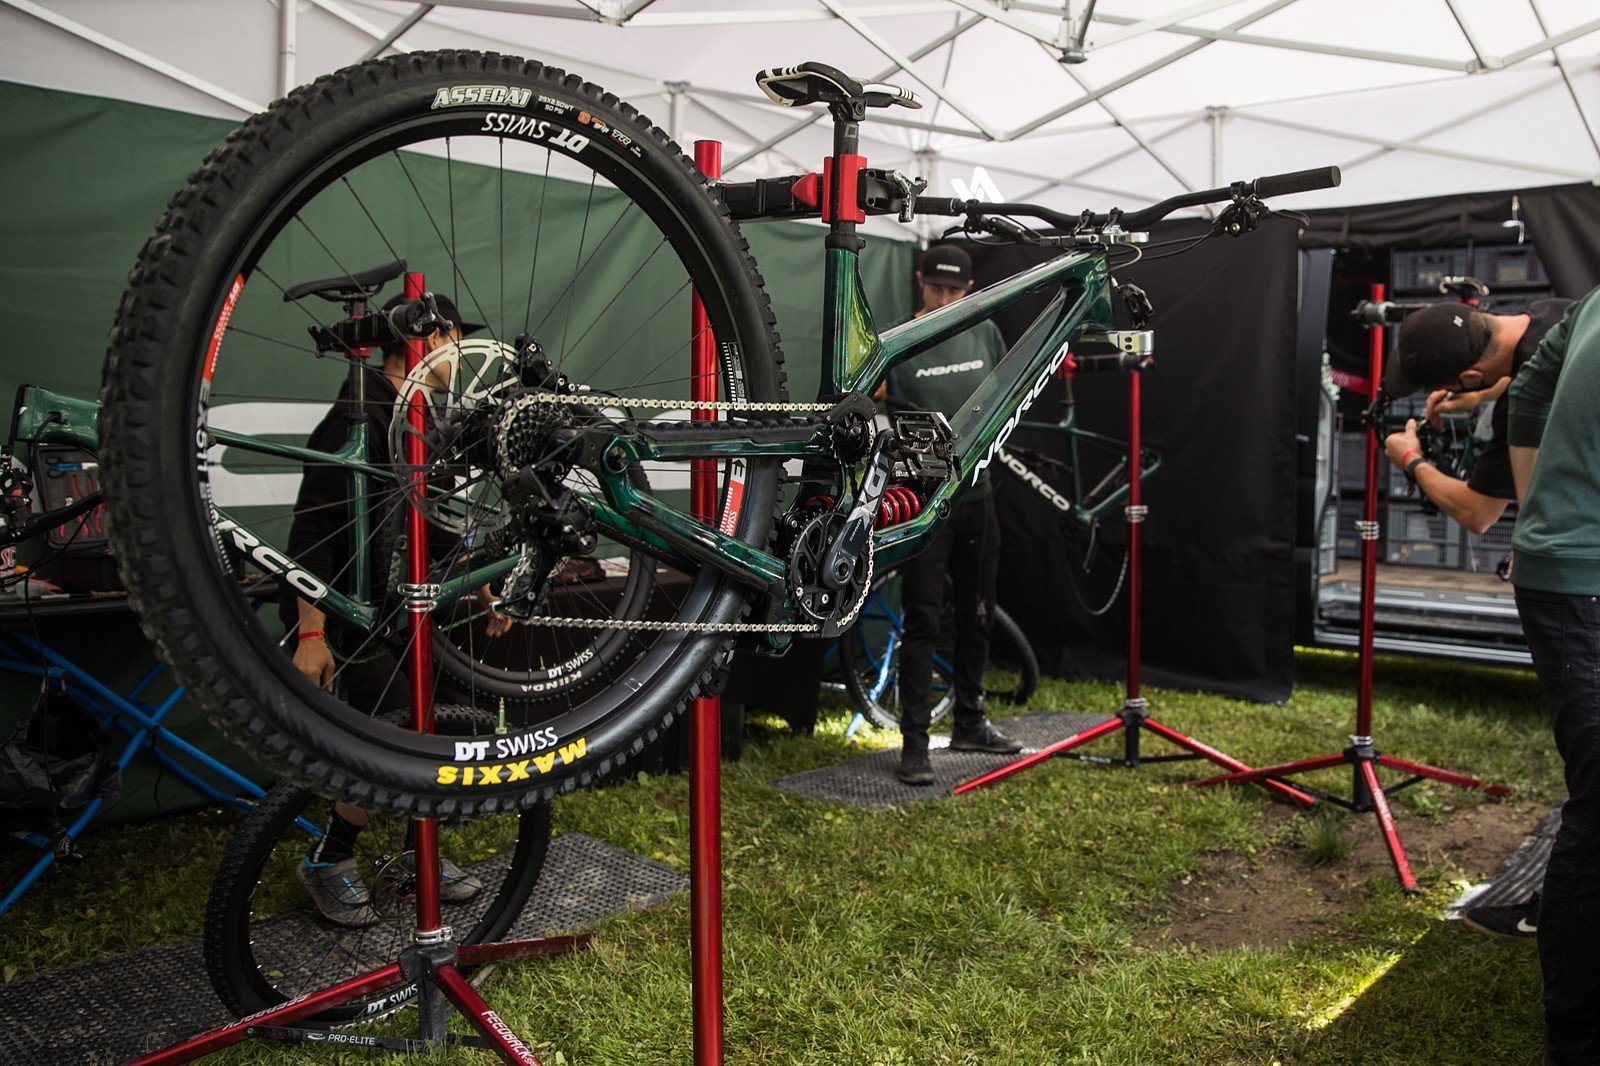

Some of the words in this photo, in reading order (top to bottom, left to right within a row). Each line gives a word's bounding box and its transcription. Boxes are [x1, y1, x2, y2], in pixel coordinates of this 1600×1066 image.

[431, 85, 532, 109] ASSEGAI
[481, 112, 551, 139] SWISS
[548, 128, 590, 154] DT
[916, 359, 983, 378] NORCO
[971, 341, 1070, 488] NORCO
[997, 447, 1071, 512] NORCO
[548, 664, 563, 680] DT
[565, 648, 594, 672] SWISS
[520, 670, 583, 692] KENDA
[454, 741, 490, 762] DT
[495, 727, 559, 759] SWISS
[436, 737, 587, 786] MAXXIS
[367, 998, 387, 1014] DT
[389, 983, 418, 1007] SWIS
[481, 1010, 535, 1060] FEEDBACK
